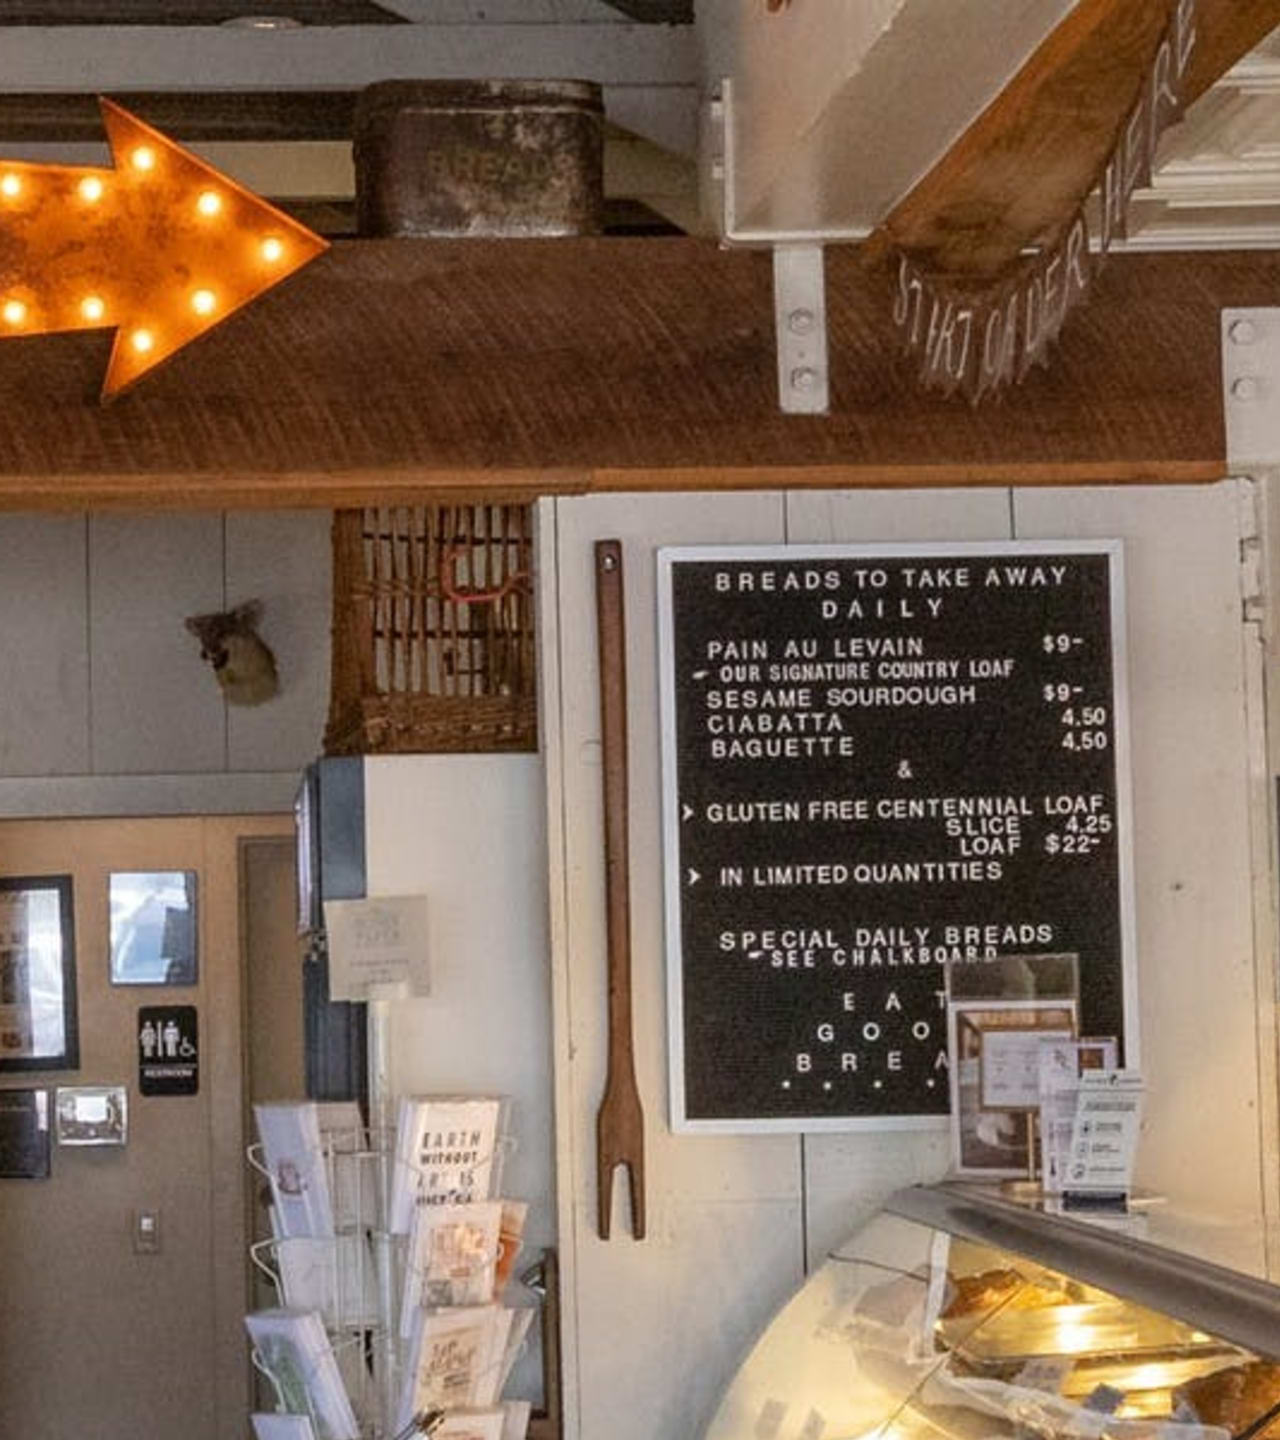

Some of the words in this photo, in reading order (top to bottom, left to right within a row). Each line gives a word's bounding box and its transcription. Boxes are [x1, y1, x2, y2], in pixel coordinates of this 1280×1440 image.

[715, 571, 842, 592] BREADS
[854, 569, 888, 590] TO
[902, 568, 970, 588] TAKE
[984, 565, 1066, 587] AWAY
[821, 598, 942, 619] DAILY
[707, 639, 768, 661] PAIN
[784, 639, 818, 659] AU
[834, 637, 923, 658] LEVAIN
[719, 664, 762, 683] OUR
[769, 662, 870, 682] SIGNATURE
[877, 660, 959, 680] COUNTRY
[969, 658, 1015, 678] LOAF
[706, 689, 812, 709] SESAME
[826, 686, 977, 706] SOURDOUGH
[706, 713, 843, 734] CIABATTA
[1061, 707, 1106, 726] 4.50
[711, 736, 855, 759] BAGUETTE
[1061, 731, 1107, 751] 4.50
[897, 760, 912, 779] &
[706, 802, 800, 823] GLUTEN
[808, 800, 870, 820] FREE
[877, 797, 1034, 820] CENTENNIAL
[1045, 794, 1105, 815] LOAF
[945, 816, 1021, 837] SLICE
[1065, 813, 1113, 834] 4.25
[960, 837, 1022, 857] LOAF
[720, 866, 744, 887] IN
[753, 865, 849, 886] LIMITED
[853, 861, 1003, 884] QUANTITIES
[719, 930, 839, 951] SPECIAL
[856, 926, 930, 948] DAILY
[945, 924, 1053, 945] BREADS
[771, 950, 816, 968] SEE
[832, 945, 999, 967] CHALKBOARD
[843, 989, 949, 1012] EAT
[817, 1021, 931, 1043] GOO
[796, 1051, 949, 1073] BREA
[420, 1151, 477, 1165] WITHOUT
